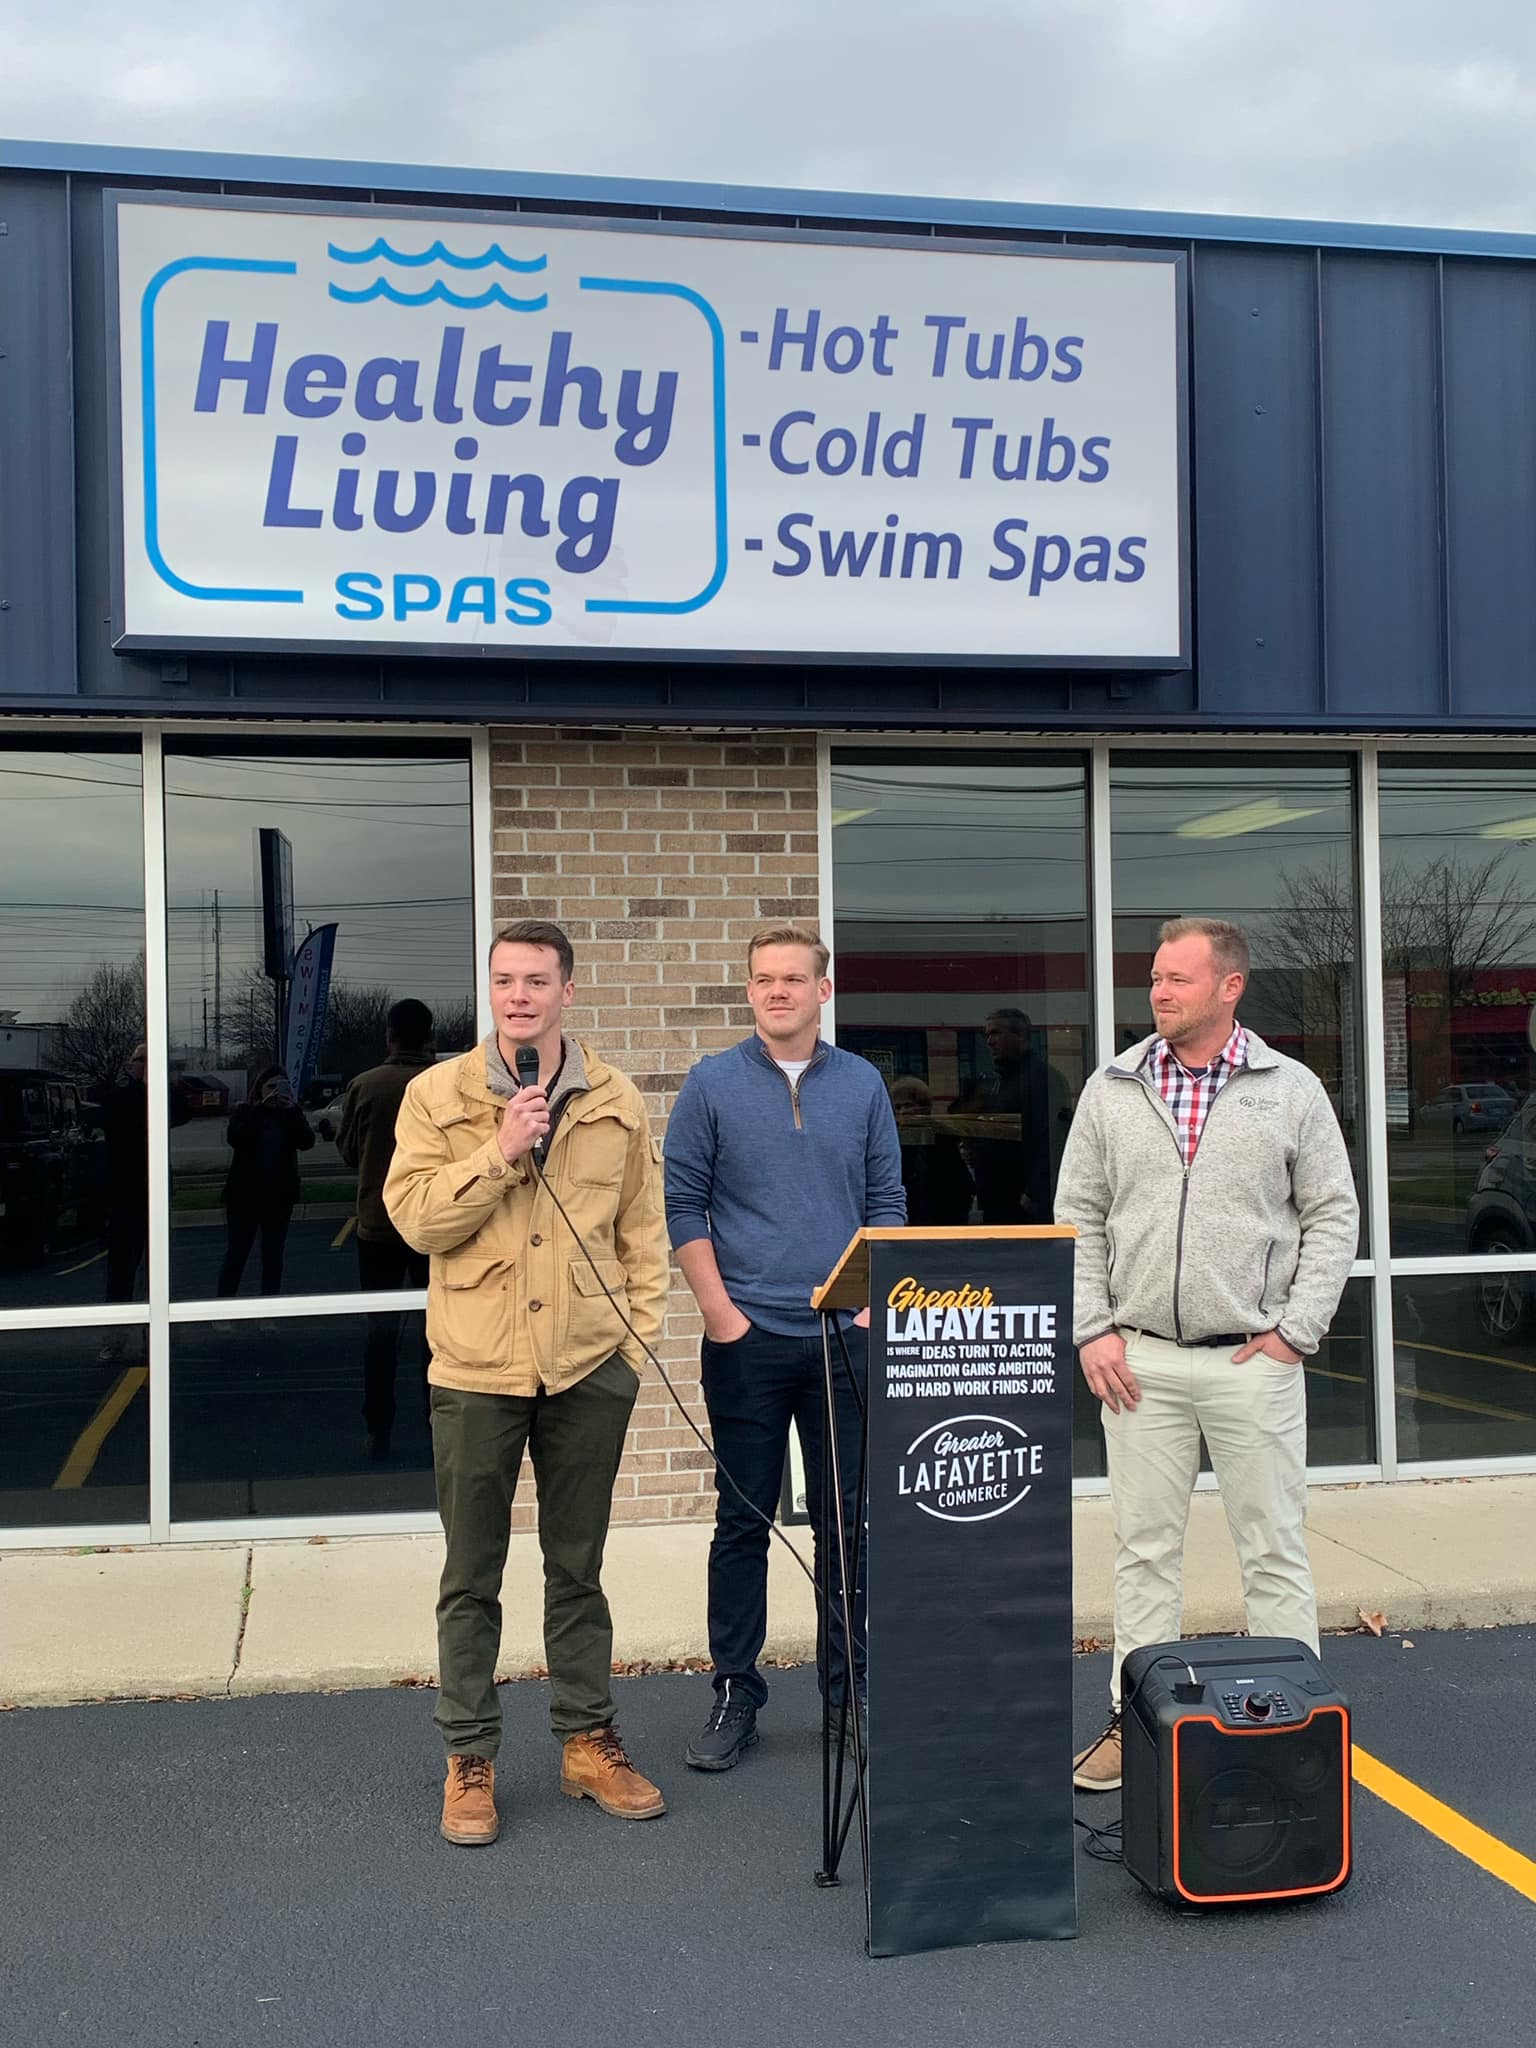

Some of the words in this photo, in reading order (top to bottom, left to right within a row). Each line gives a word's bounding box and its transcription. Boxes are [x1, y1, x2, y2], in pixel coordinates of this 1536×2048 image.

[924, 314, 1085, 383] Tubs
[193, 320, 679, 466] Healthy
[951, 417, 1112, 484] Tubs
[262, 432, 621, 574] Living
[988, 518, 1148, 597] Spas
[334, 571, 553, 627] SPAS
[887, 1276, 994, 1312] Greater
[886, 1305, 1057, 1342] LAFAYETTE
[886, 1347, 895, 1356] IS
[895, 1346, 920, 1356] WHERE
[922, 1345, 956, 1360] IDEAS
[958, 1344, 990, 1359] TURN
[992, 1344, 1007, 1358] TO
[1009, 1343, 1056, 1359] ACTION,
[886, 1363, 960, 1379] IMAGINATION
[962, 1362, 996, 1377] GAINS
[998, 1361, 1056, 1377] AMBITION,
[886, 1383, 913, 1398] AND
[916, 1381, 951, 1397] HARD
[953, 1380, 991, 1396] WORK
[992, 1379, 1028, 1395] FINDS
[1030, 1379, 1056, 1394] JOY.
[934, 1430, 1004, 1456] Greater
[898, 1445, 1043, 1495] LAFAYETTE
[938, 1483, 1008, 1508] COMMERCE
